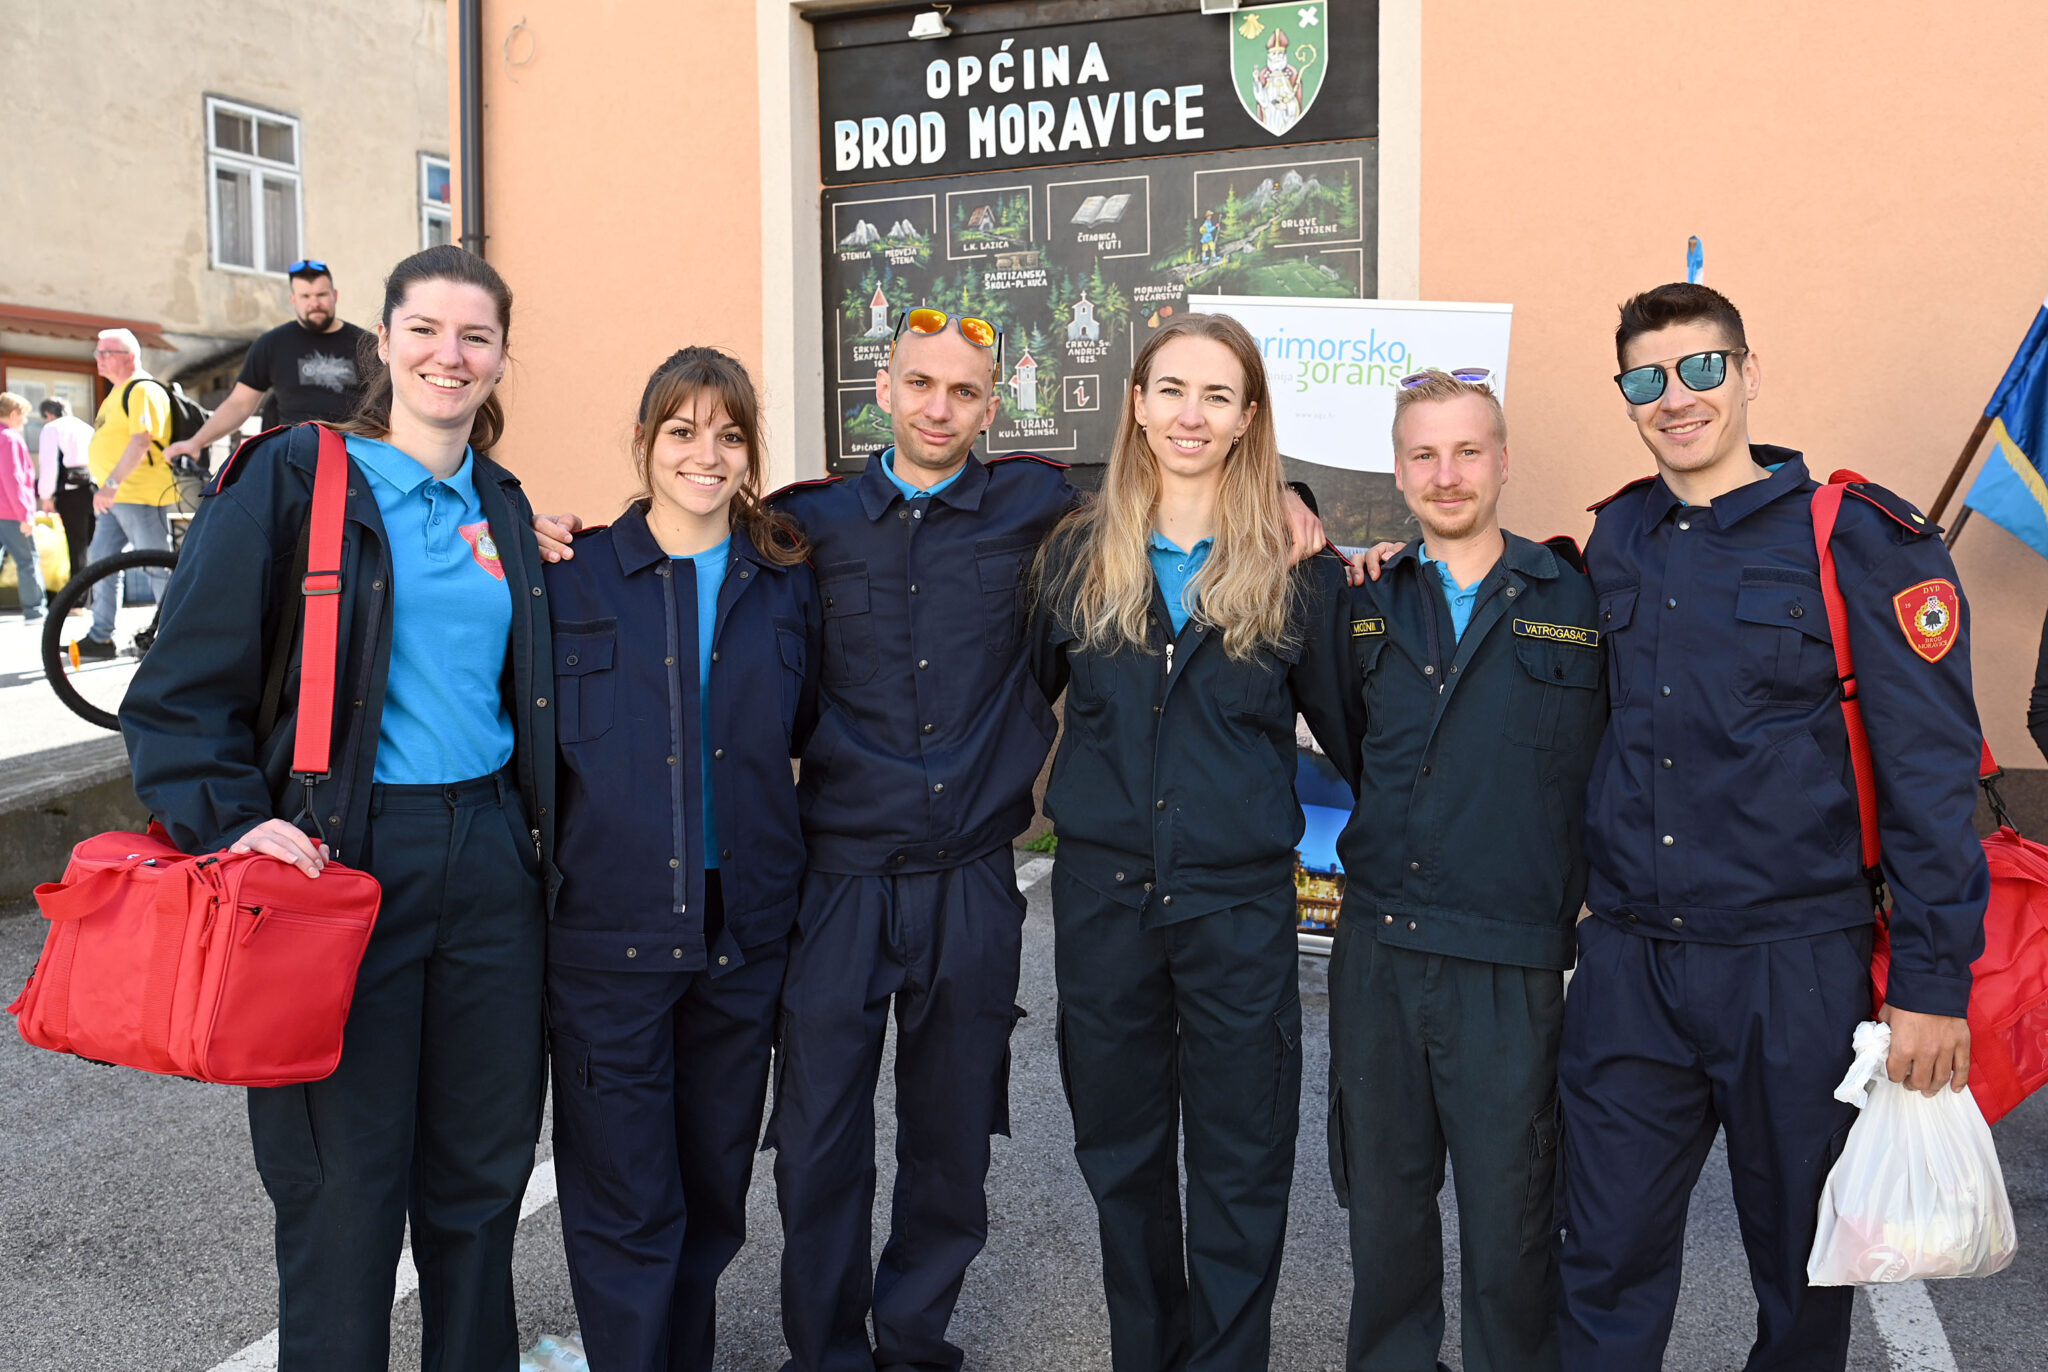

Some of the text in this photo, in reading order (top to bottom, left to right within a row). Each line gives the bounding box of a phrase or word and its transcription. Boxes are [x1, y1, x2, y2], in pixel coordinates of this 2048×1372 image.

[926, 38, 1110, 99] OPĆINA
[835, 85, 1204, 171] BROD MORAVICE
[1281, 217, 1318, 228] ORLOVE
[1298, 224, 1338, 235] STIJENE
[1077, 232, 1117, 242] ČITAONICA
[963, 241, 1009, 251] L.K. LAZICA
[1098, 240, 1122, 250] KUTI
[890, 256, 915, 265] STENA
[984, 270, 1047, 281] PARTIZANSKA
[1134, 282, 1185, 294] MORAVIČKO
[853, 345, 880, 354] CRKVA
[1065, 341, 1095, 349] CRKVA
[1067, 347, 1107, 356] ANDRIJE
[1013, 418, 1054, 429] TURANJ
[998, 428, 1059, 438] KULA ZRINSKI
[1923, 585, 1940, 594] DVD
[1525, 624, 1587, 642] VATROGASAC
